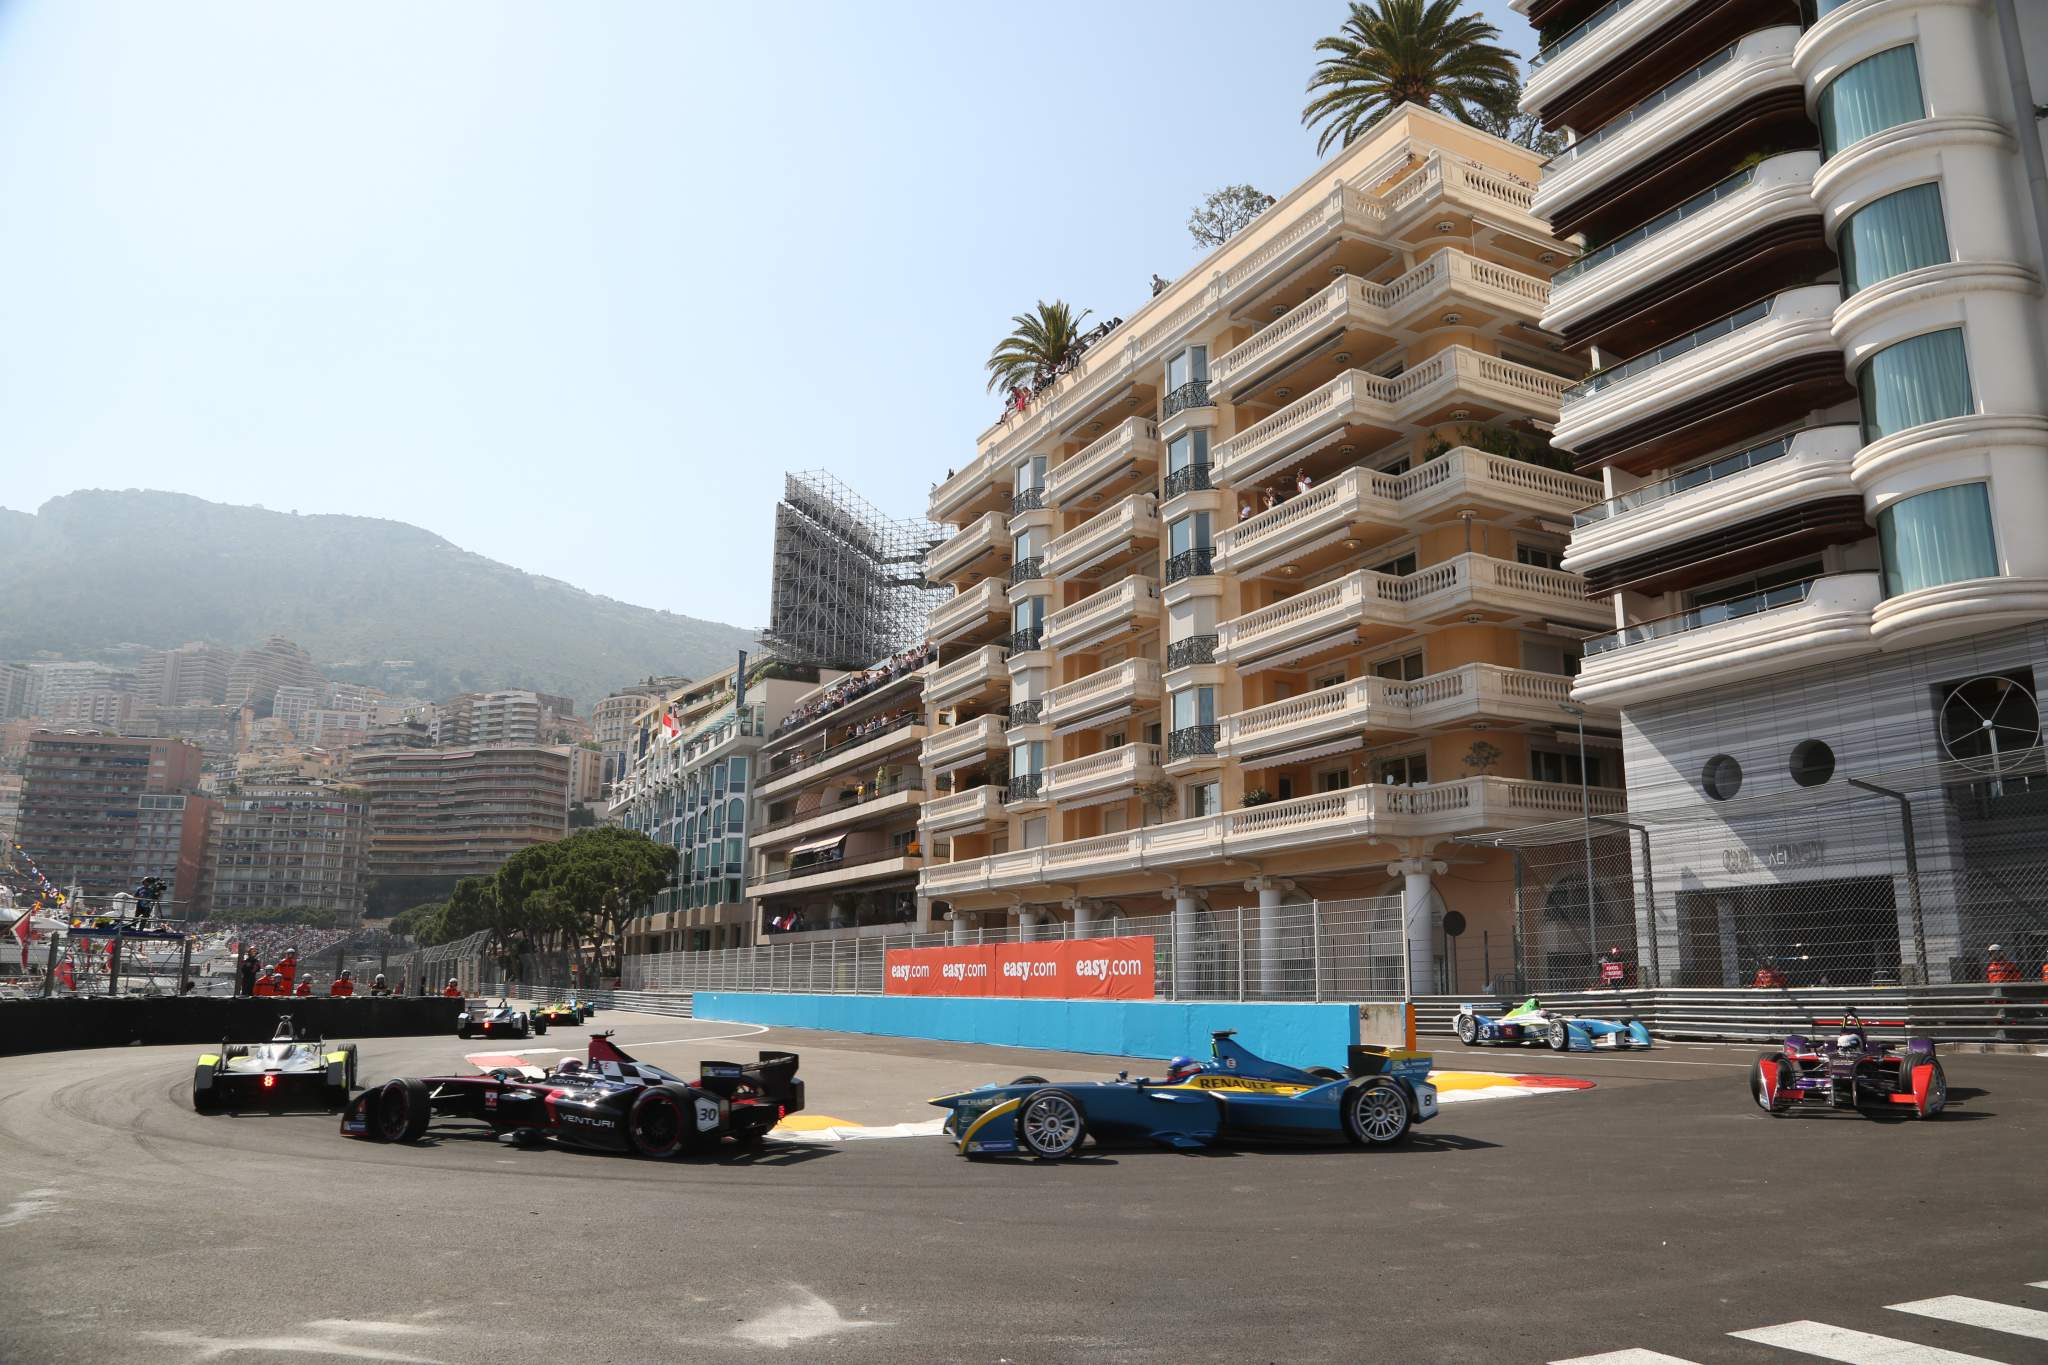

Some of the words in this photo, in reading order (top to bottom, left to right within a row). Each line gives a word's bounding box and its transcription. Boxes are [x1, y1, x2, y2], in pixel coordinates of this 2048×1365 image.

[891, 964, 930, 982] easy.com
[942, 963, 987, 982] easy.com
[1003, 960, 1057, 981] easy.com
[1075, 957, 1142, 981] easy.com
[1199, 1078, 1267, 1090] RENAULT
[1424, 1094, 1432, 1107] 8
[559, 1112, 616, 1128] VENTURI
[699, 1107, 717, 1121] 30
